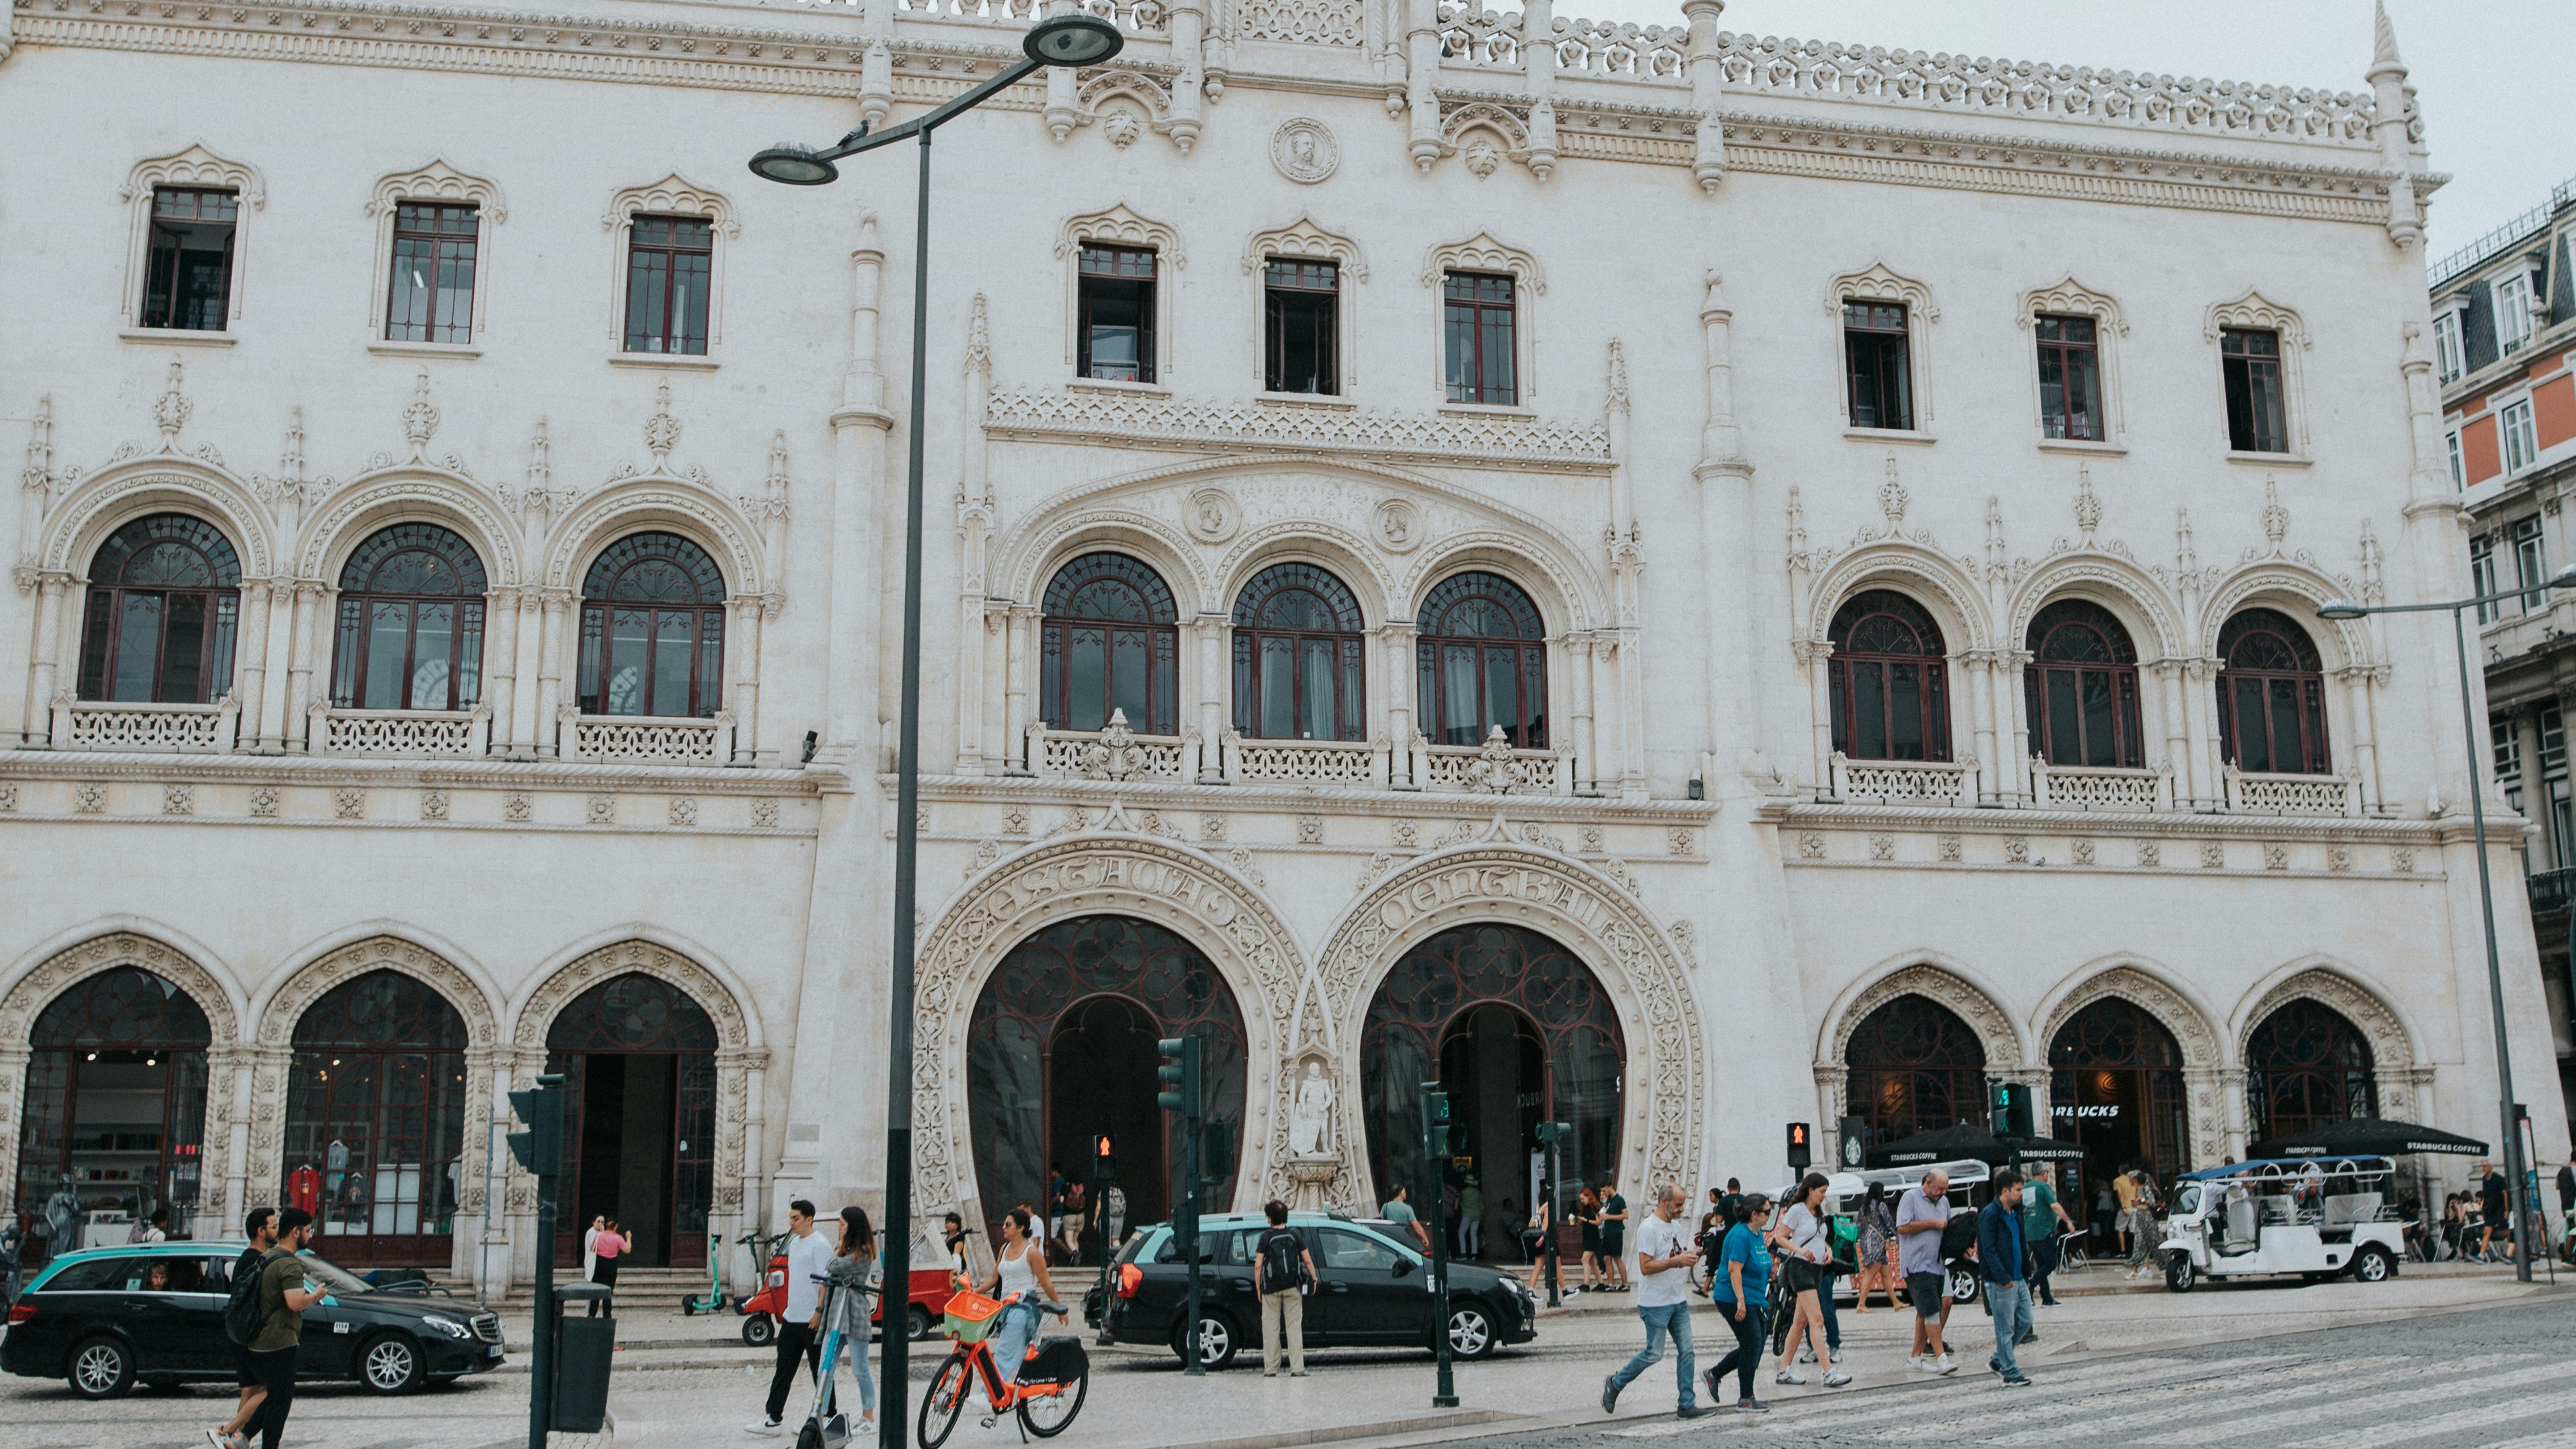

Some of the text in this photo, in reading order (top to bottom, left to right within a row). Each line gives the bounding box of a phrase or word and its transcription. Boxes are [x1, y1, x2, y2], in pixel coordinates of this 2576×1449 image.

[1380, 866, 1618, 935] CENTRAL
[2407, 1141, 2481, 1153] STARBUCKS COFFEE
[1890, 1152, 1937, 1162] STARBUCKS COFFEE
[2058, 1150, 2084, 1158] COFFEE
